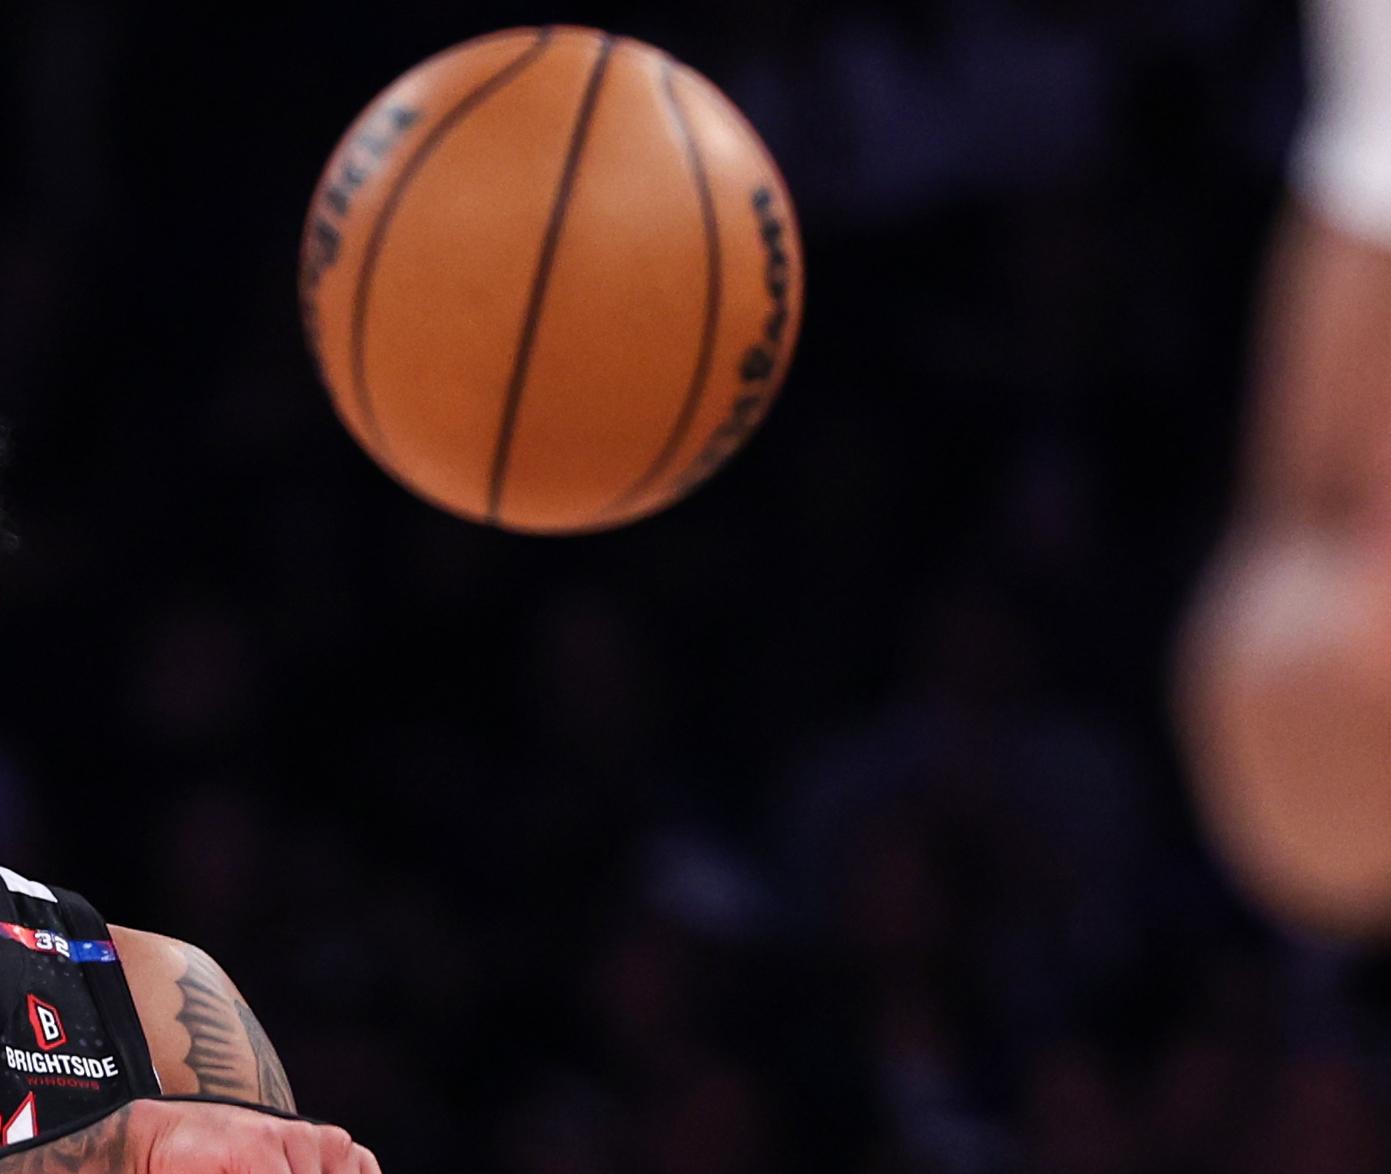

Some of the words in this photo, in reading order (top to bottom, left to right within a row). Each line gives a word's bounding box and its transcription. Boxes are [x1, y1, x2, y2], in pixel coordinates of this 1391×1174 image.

[35, 931, 71, 958] 32
[37, 1006, 60, 1041] B
[5, 1046, 119, 1079] BRIGHTSIDE
